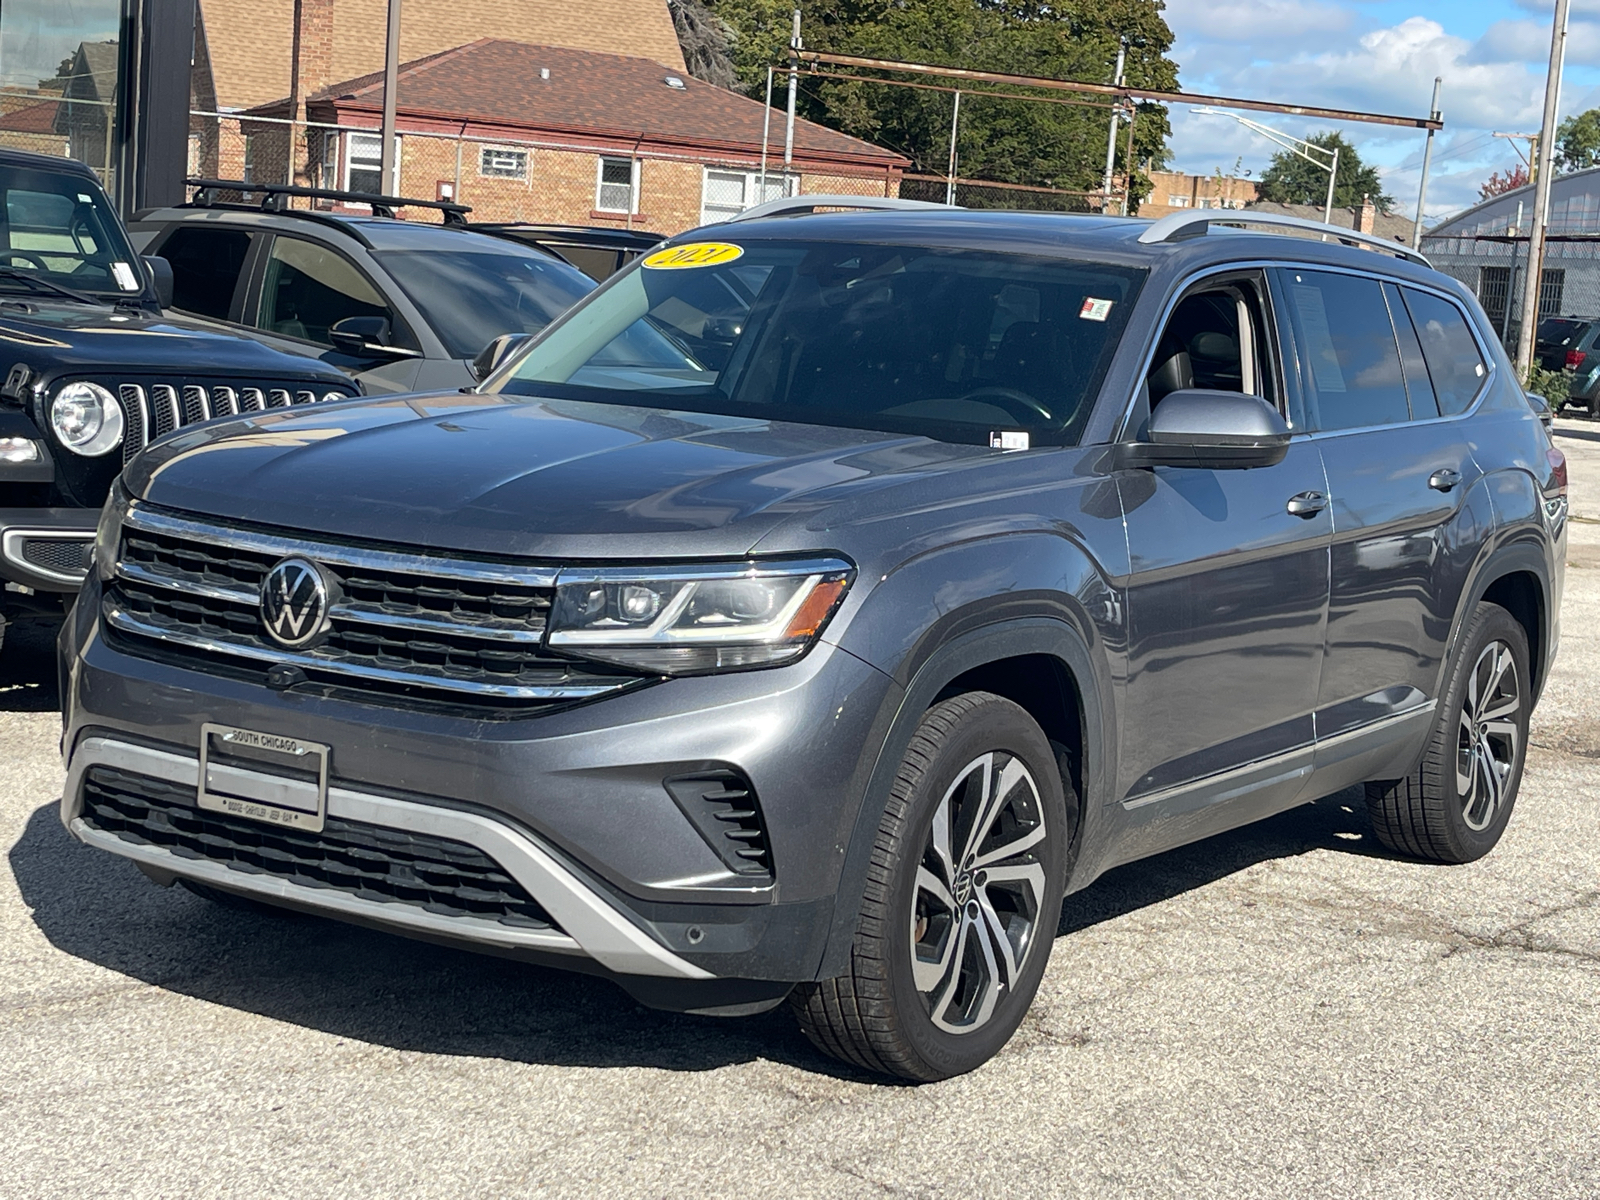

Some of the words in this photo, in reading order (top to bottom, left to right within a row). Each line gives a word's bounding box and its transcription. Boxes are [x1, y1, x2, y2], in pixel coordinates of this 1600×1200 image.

[263, 562, 323, 642] VW
[232, 730, 259, 745] SOUTH
[260, 736, 297, 752] CHICAGO
